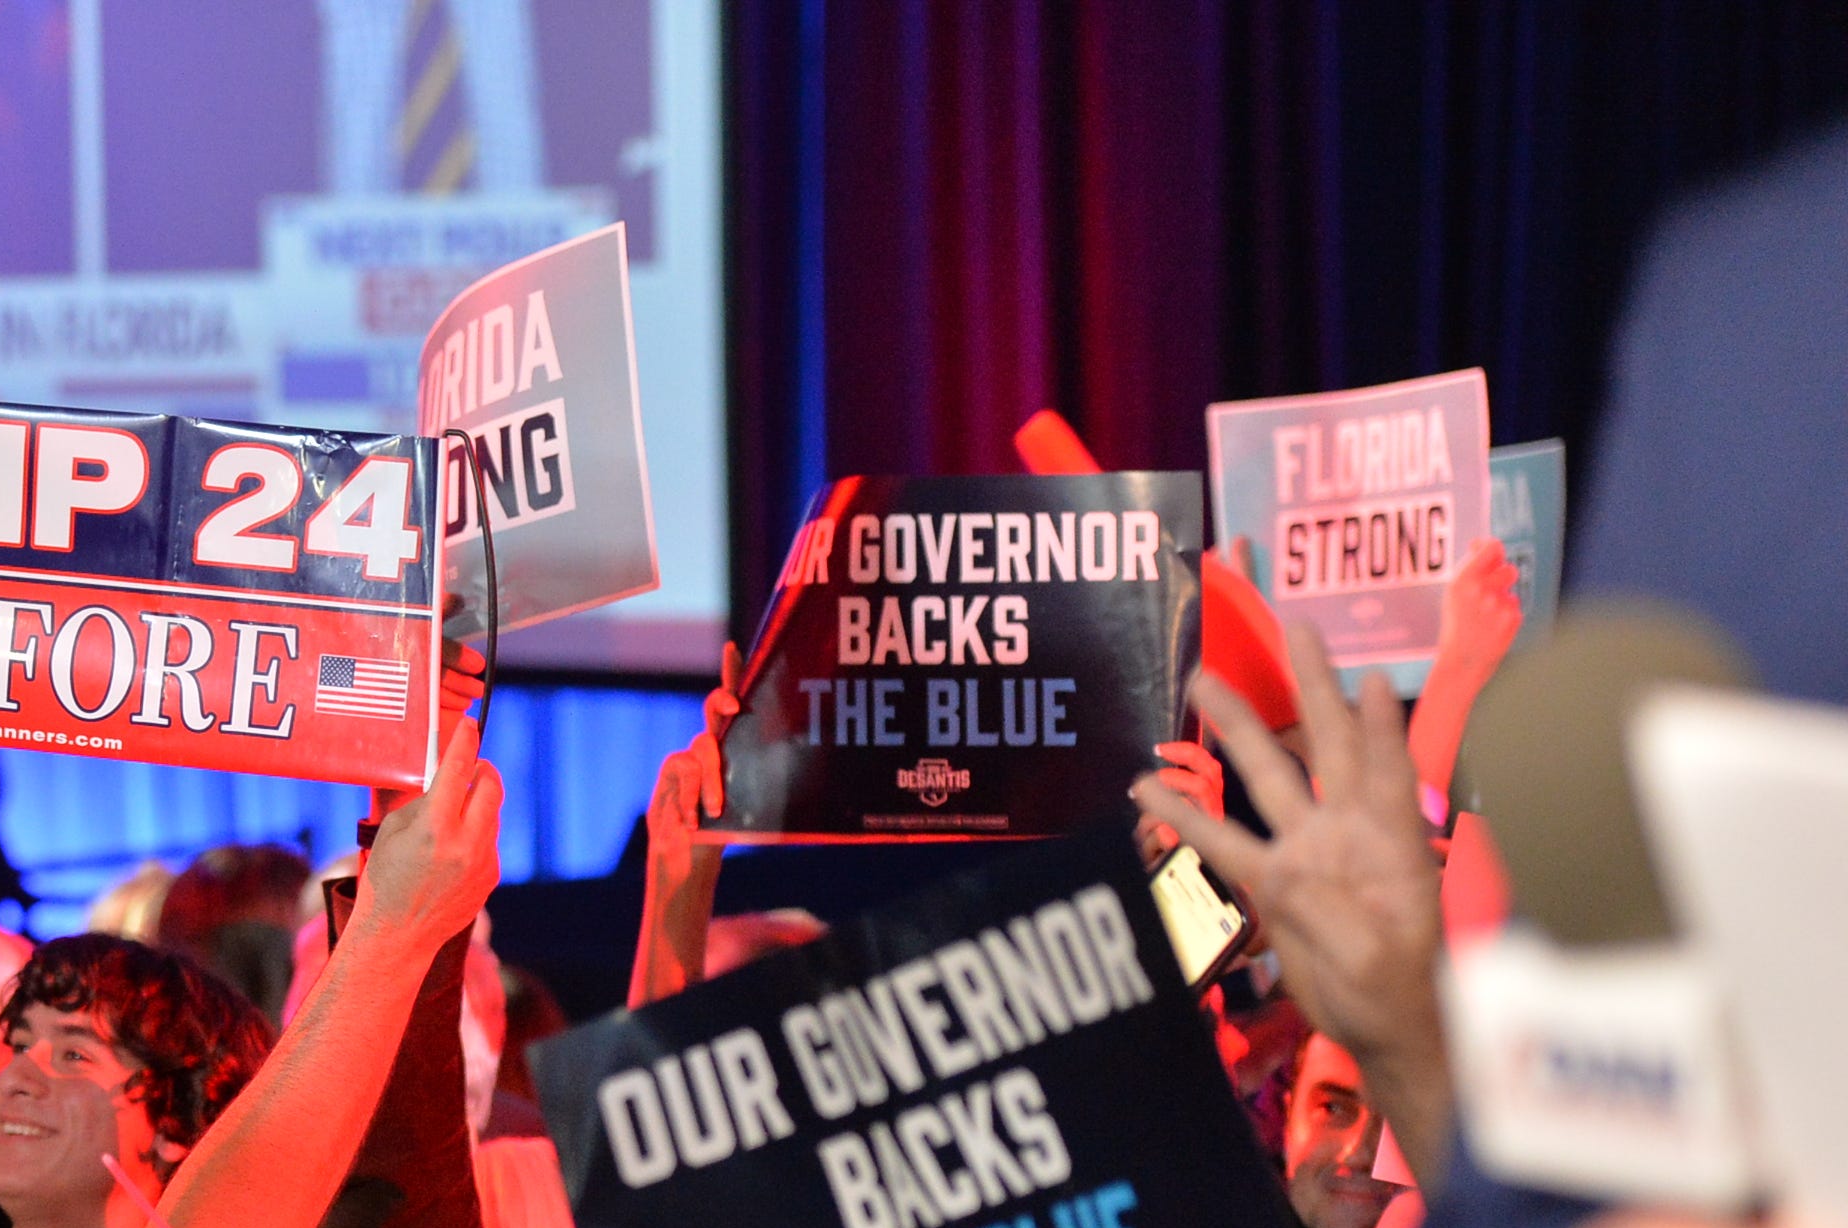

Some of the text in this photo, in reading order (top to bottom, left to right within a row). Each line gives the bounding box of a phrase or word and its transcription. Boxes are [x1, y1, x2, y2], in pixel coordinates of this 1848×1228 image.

[423, 289, 564, 437] ORIDA
[445, 412, 564, 538] ONG
[1273, 406, 1454, 504] FLORIDA
[192, 442, 422, 583] 24
[848, 511, 1160, 584] GOVERNOR
[1287, 506, 1445, 586] STRONG
[837, 595, 1029, 665] BACKS
[798, 678, 1077, 747] THE BLUE
[897, 768, 971, 789] DESANTIS
[597, 883, 1155, 1190] OUR GOVERNOR
